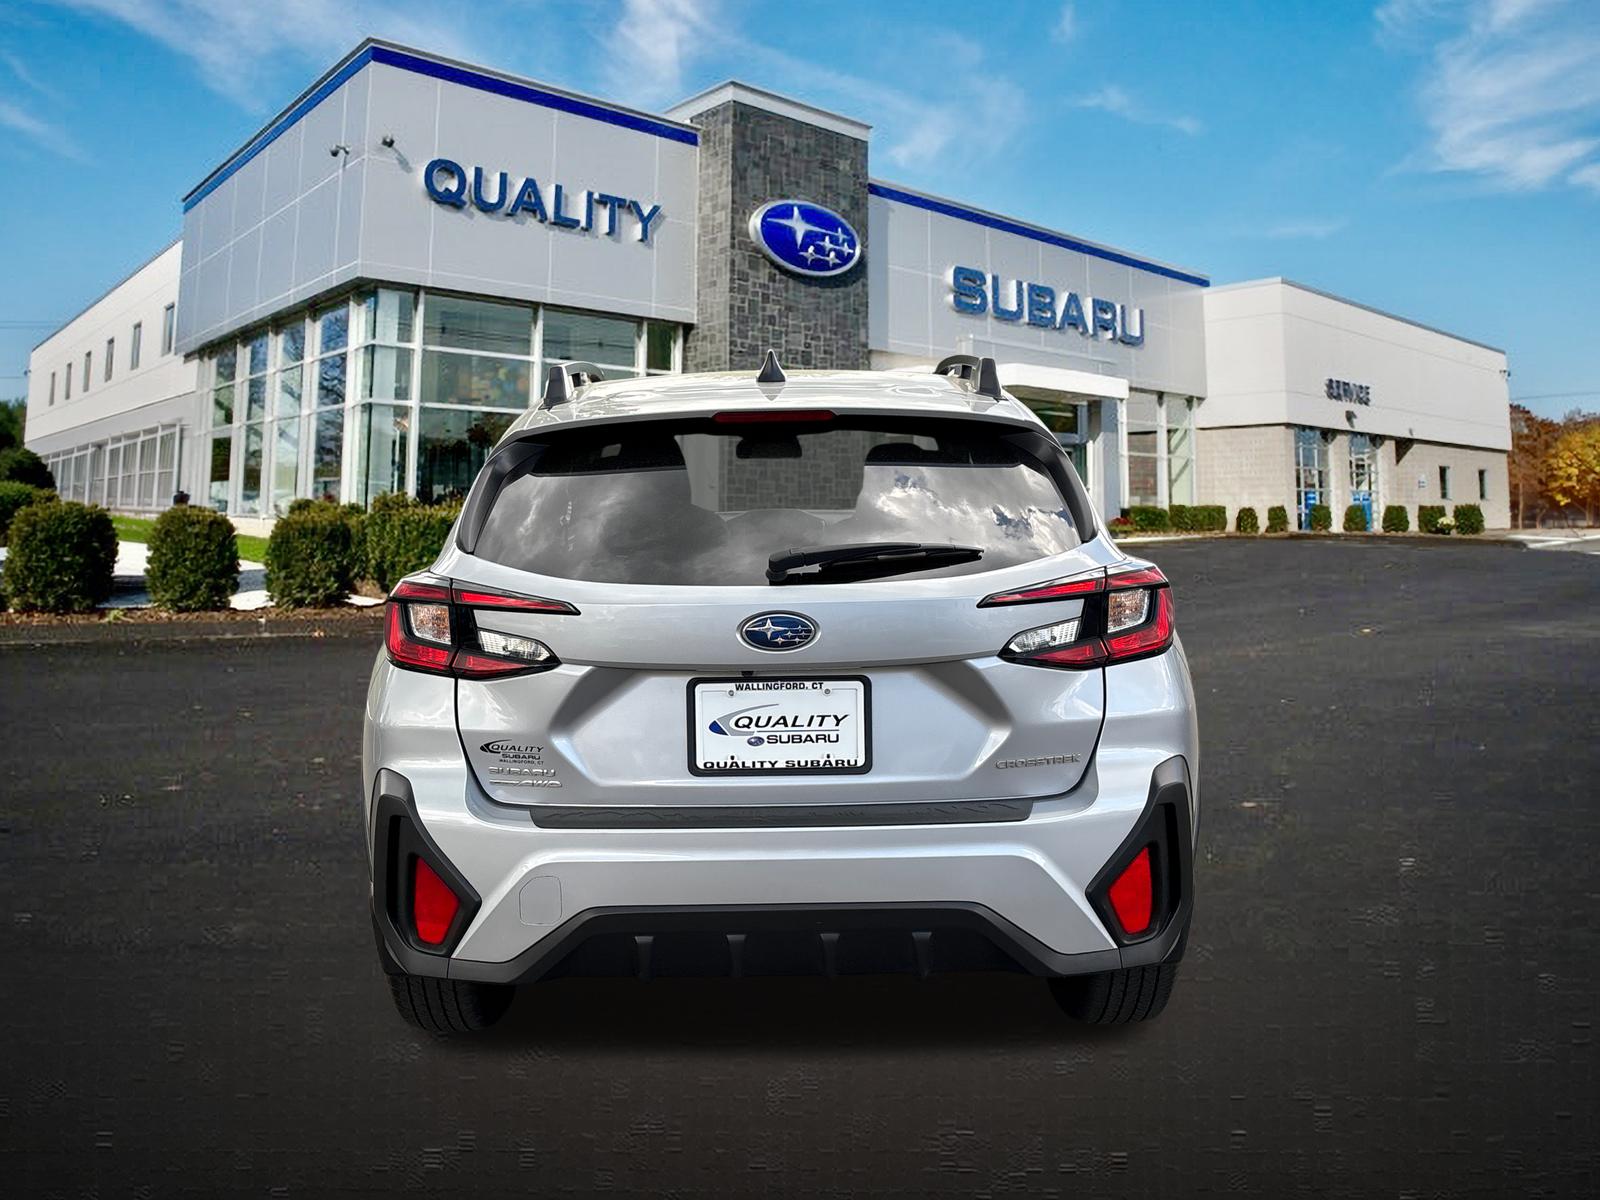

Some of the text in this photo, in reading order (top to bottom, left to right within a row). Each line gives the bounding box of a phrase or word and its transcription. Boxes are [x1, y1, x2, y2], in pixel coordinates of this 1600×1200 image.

[423, 158, 661, 243] QUALITY
[949, 265, 1145, 346] SUBARU
[811, 681, 824, 690] CT
[734, 714, 850, 729] QUALITY
[766, 734, 840, 745] SUBARU
[491, 744, 544, 752] QUALITY
[703, 758, 858, 769] QUALITY SUBARU
[994, 753, 1081, 770] CROSSTREK
[488, 766, 556, 778] SUBARU
